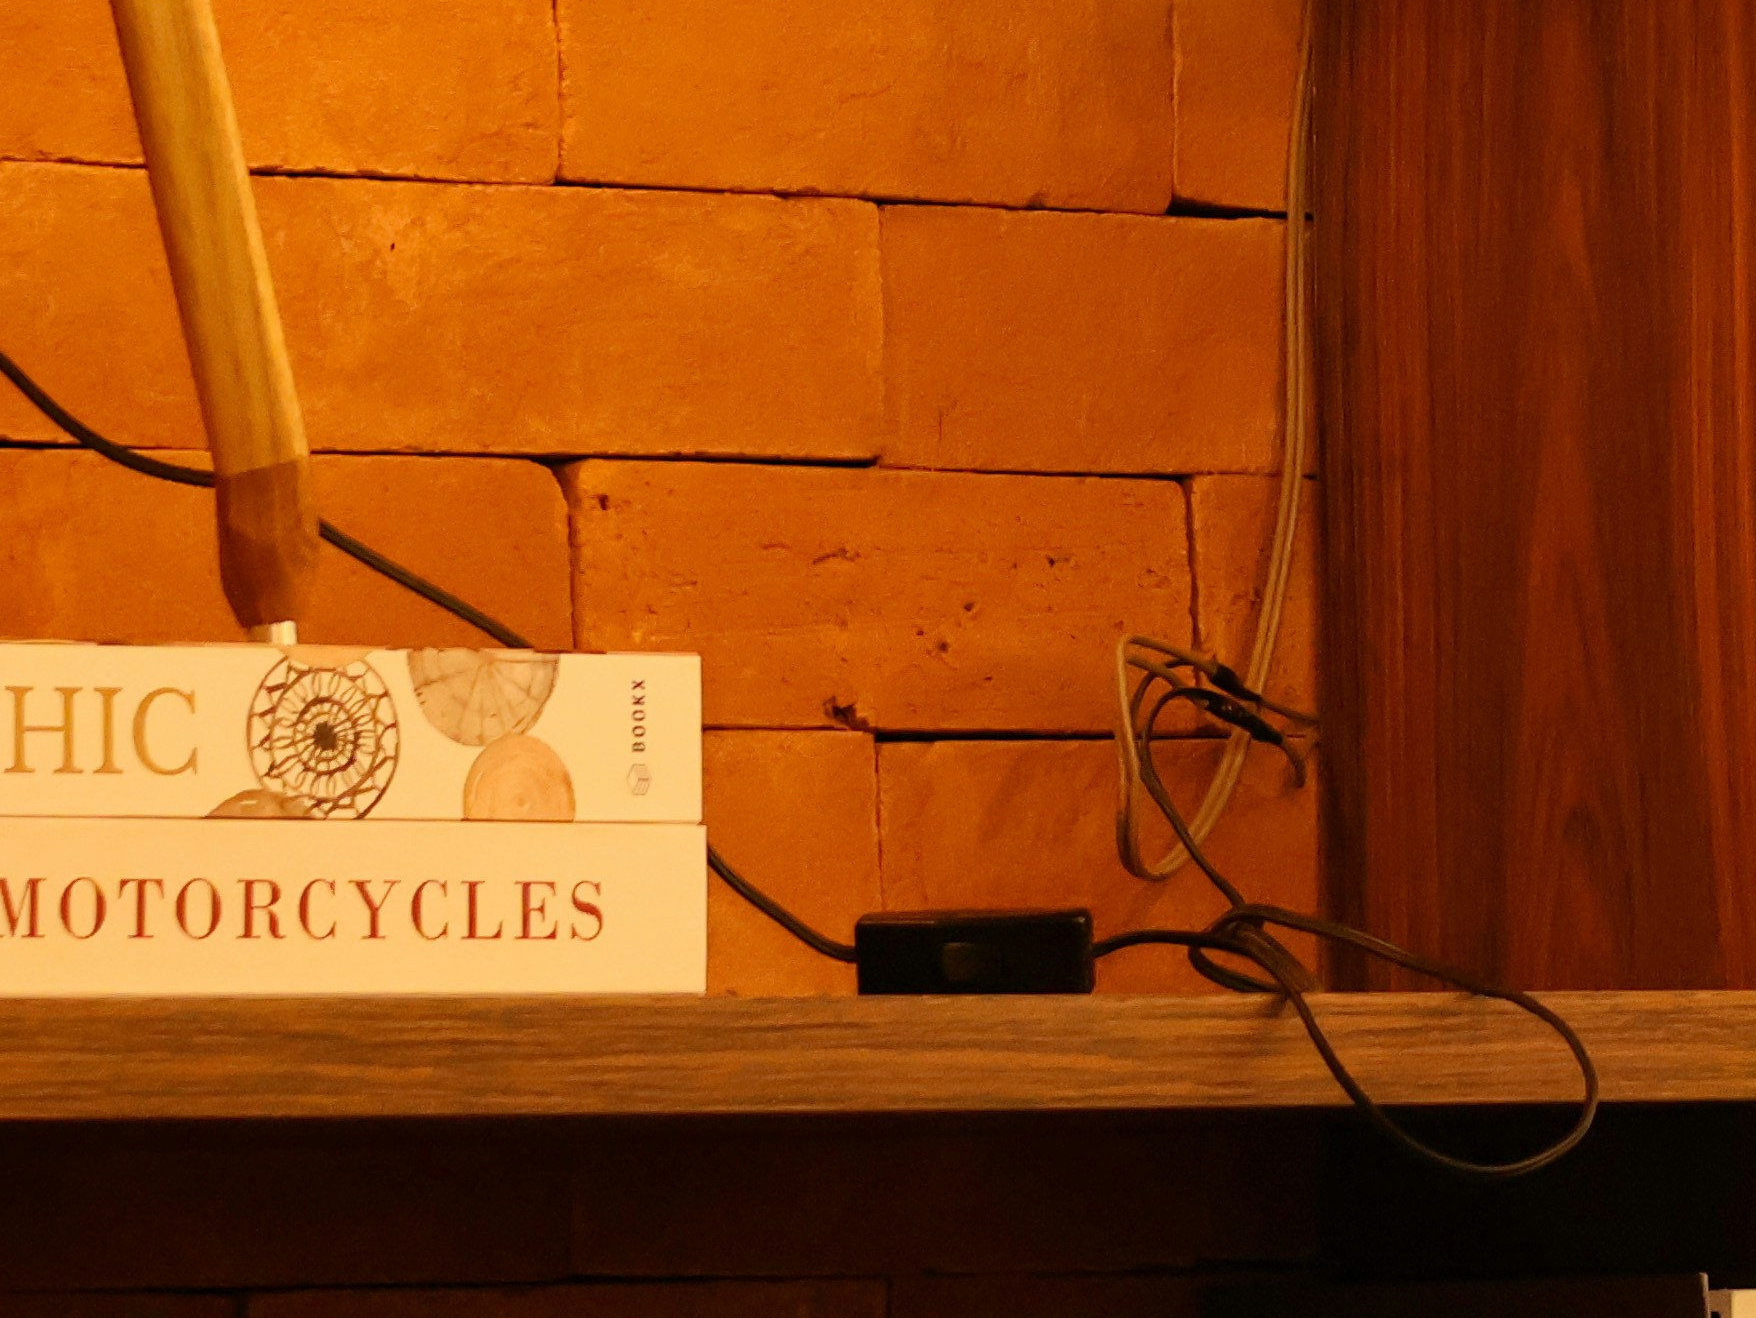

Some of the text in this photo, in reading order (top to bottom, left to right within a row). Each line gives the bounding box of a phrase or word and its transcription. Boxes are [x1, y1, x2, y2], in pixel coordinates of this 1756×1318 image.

[3, 684, 199, 776] HIC
[631, 679, 646, 753] BOOKX
[0, 875, 604, 941] MOTORCYCLES
